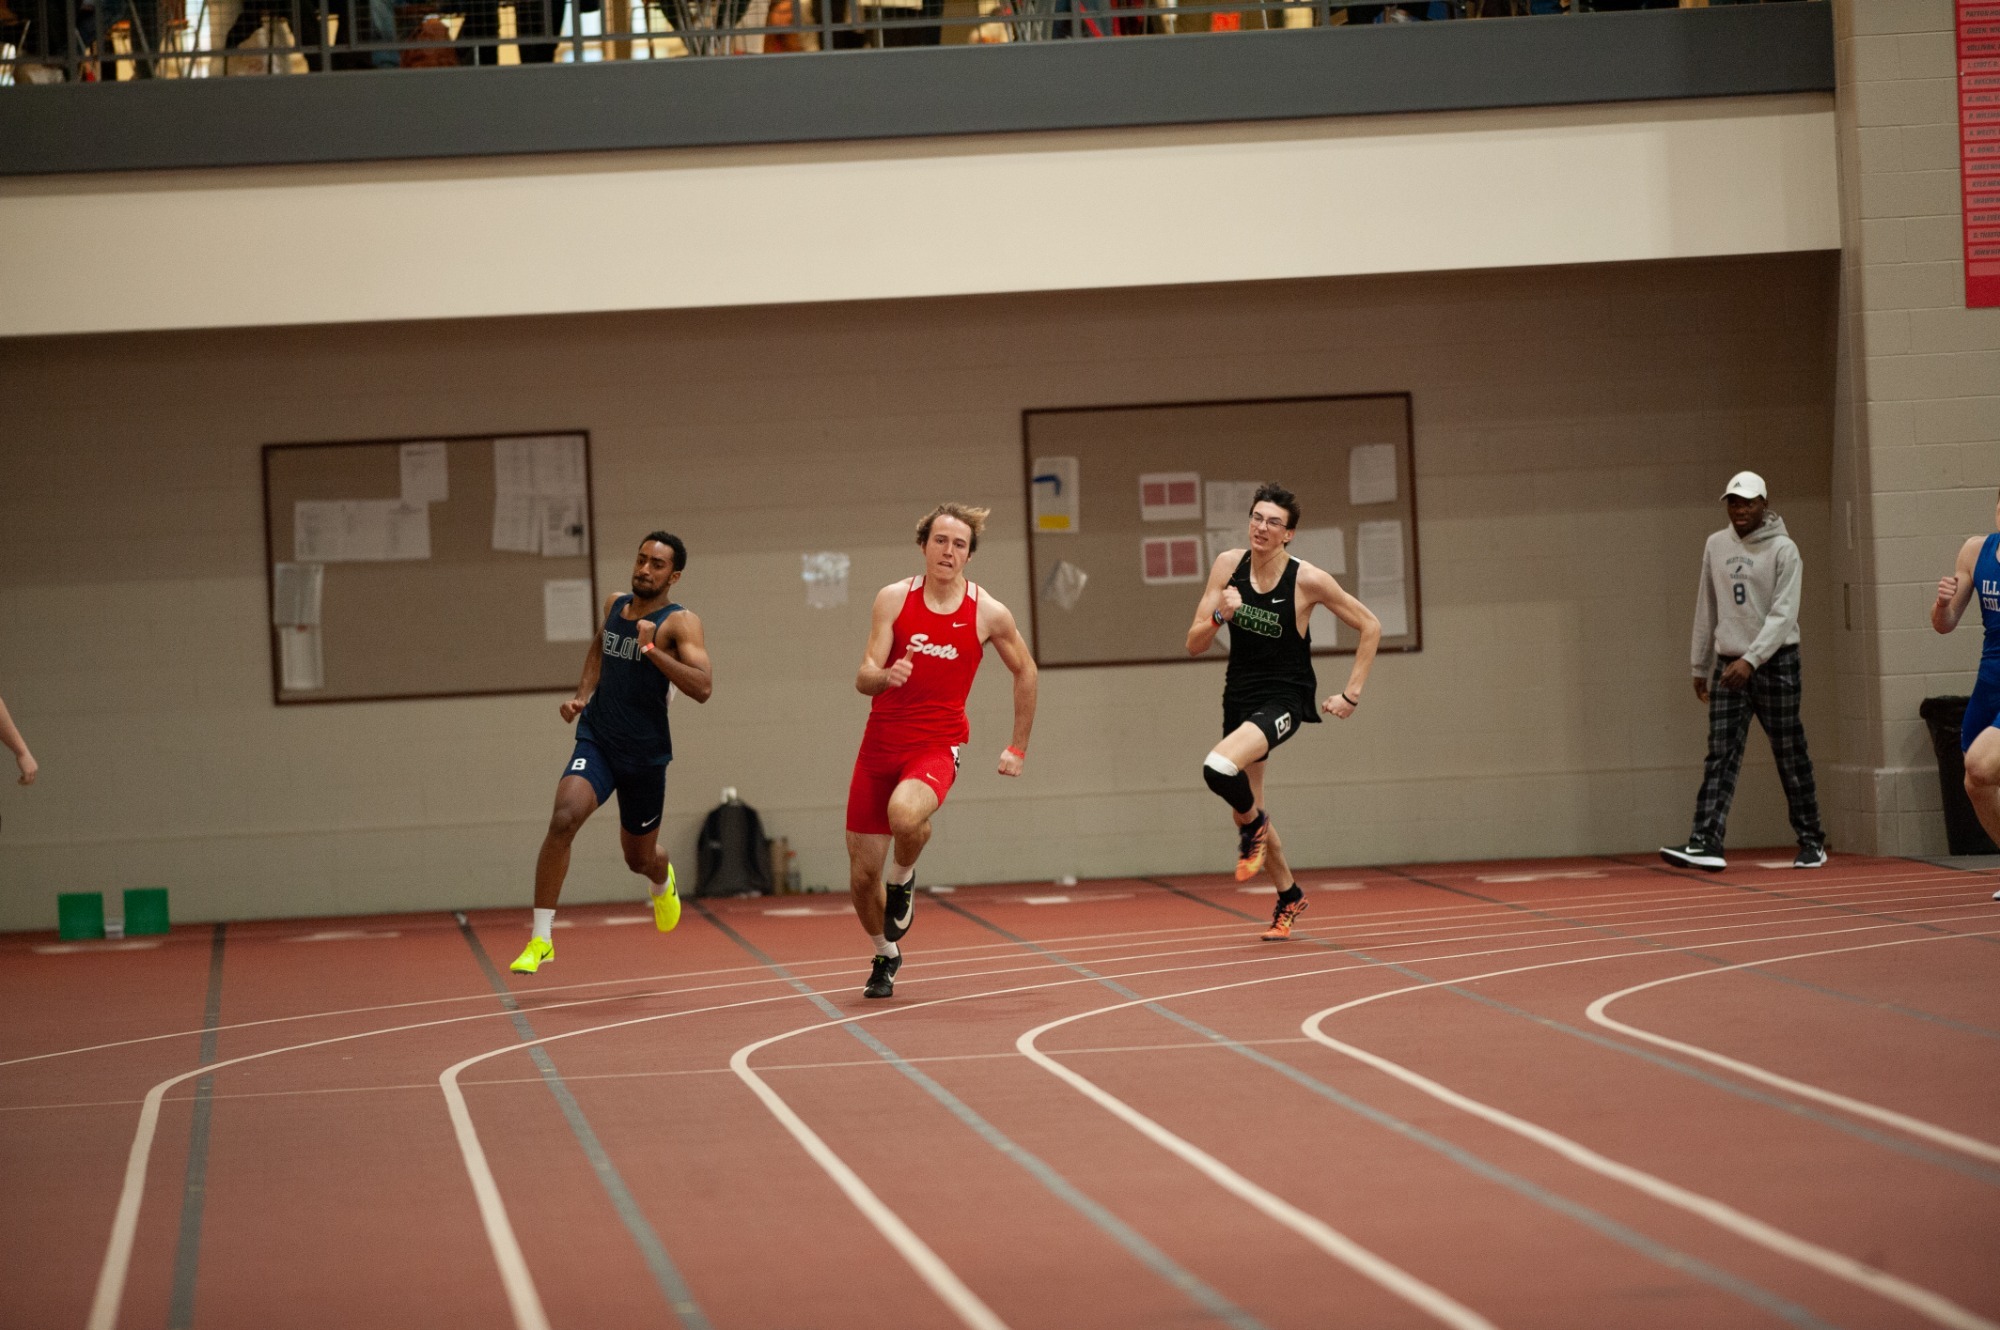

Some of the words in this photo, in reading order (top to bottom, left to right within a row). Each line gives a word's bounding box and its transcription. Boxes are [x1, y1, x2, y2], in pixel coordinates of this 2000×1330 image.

[1733, 583, 1746, 606] 8
[1236, 603, 1279, 623] ILLIAM
[906, 633, 959, 660] Scots
[571, 757, 587, 770] B
